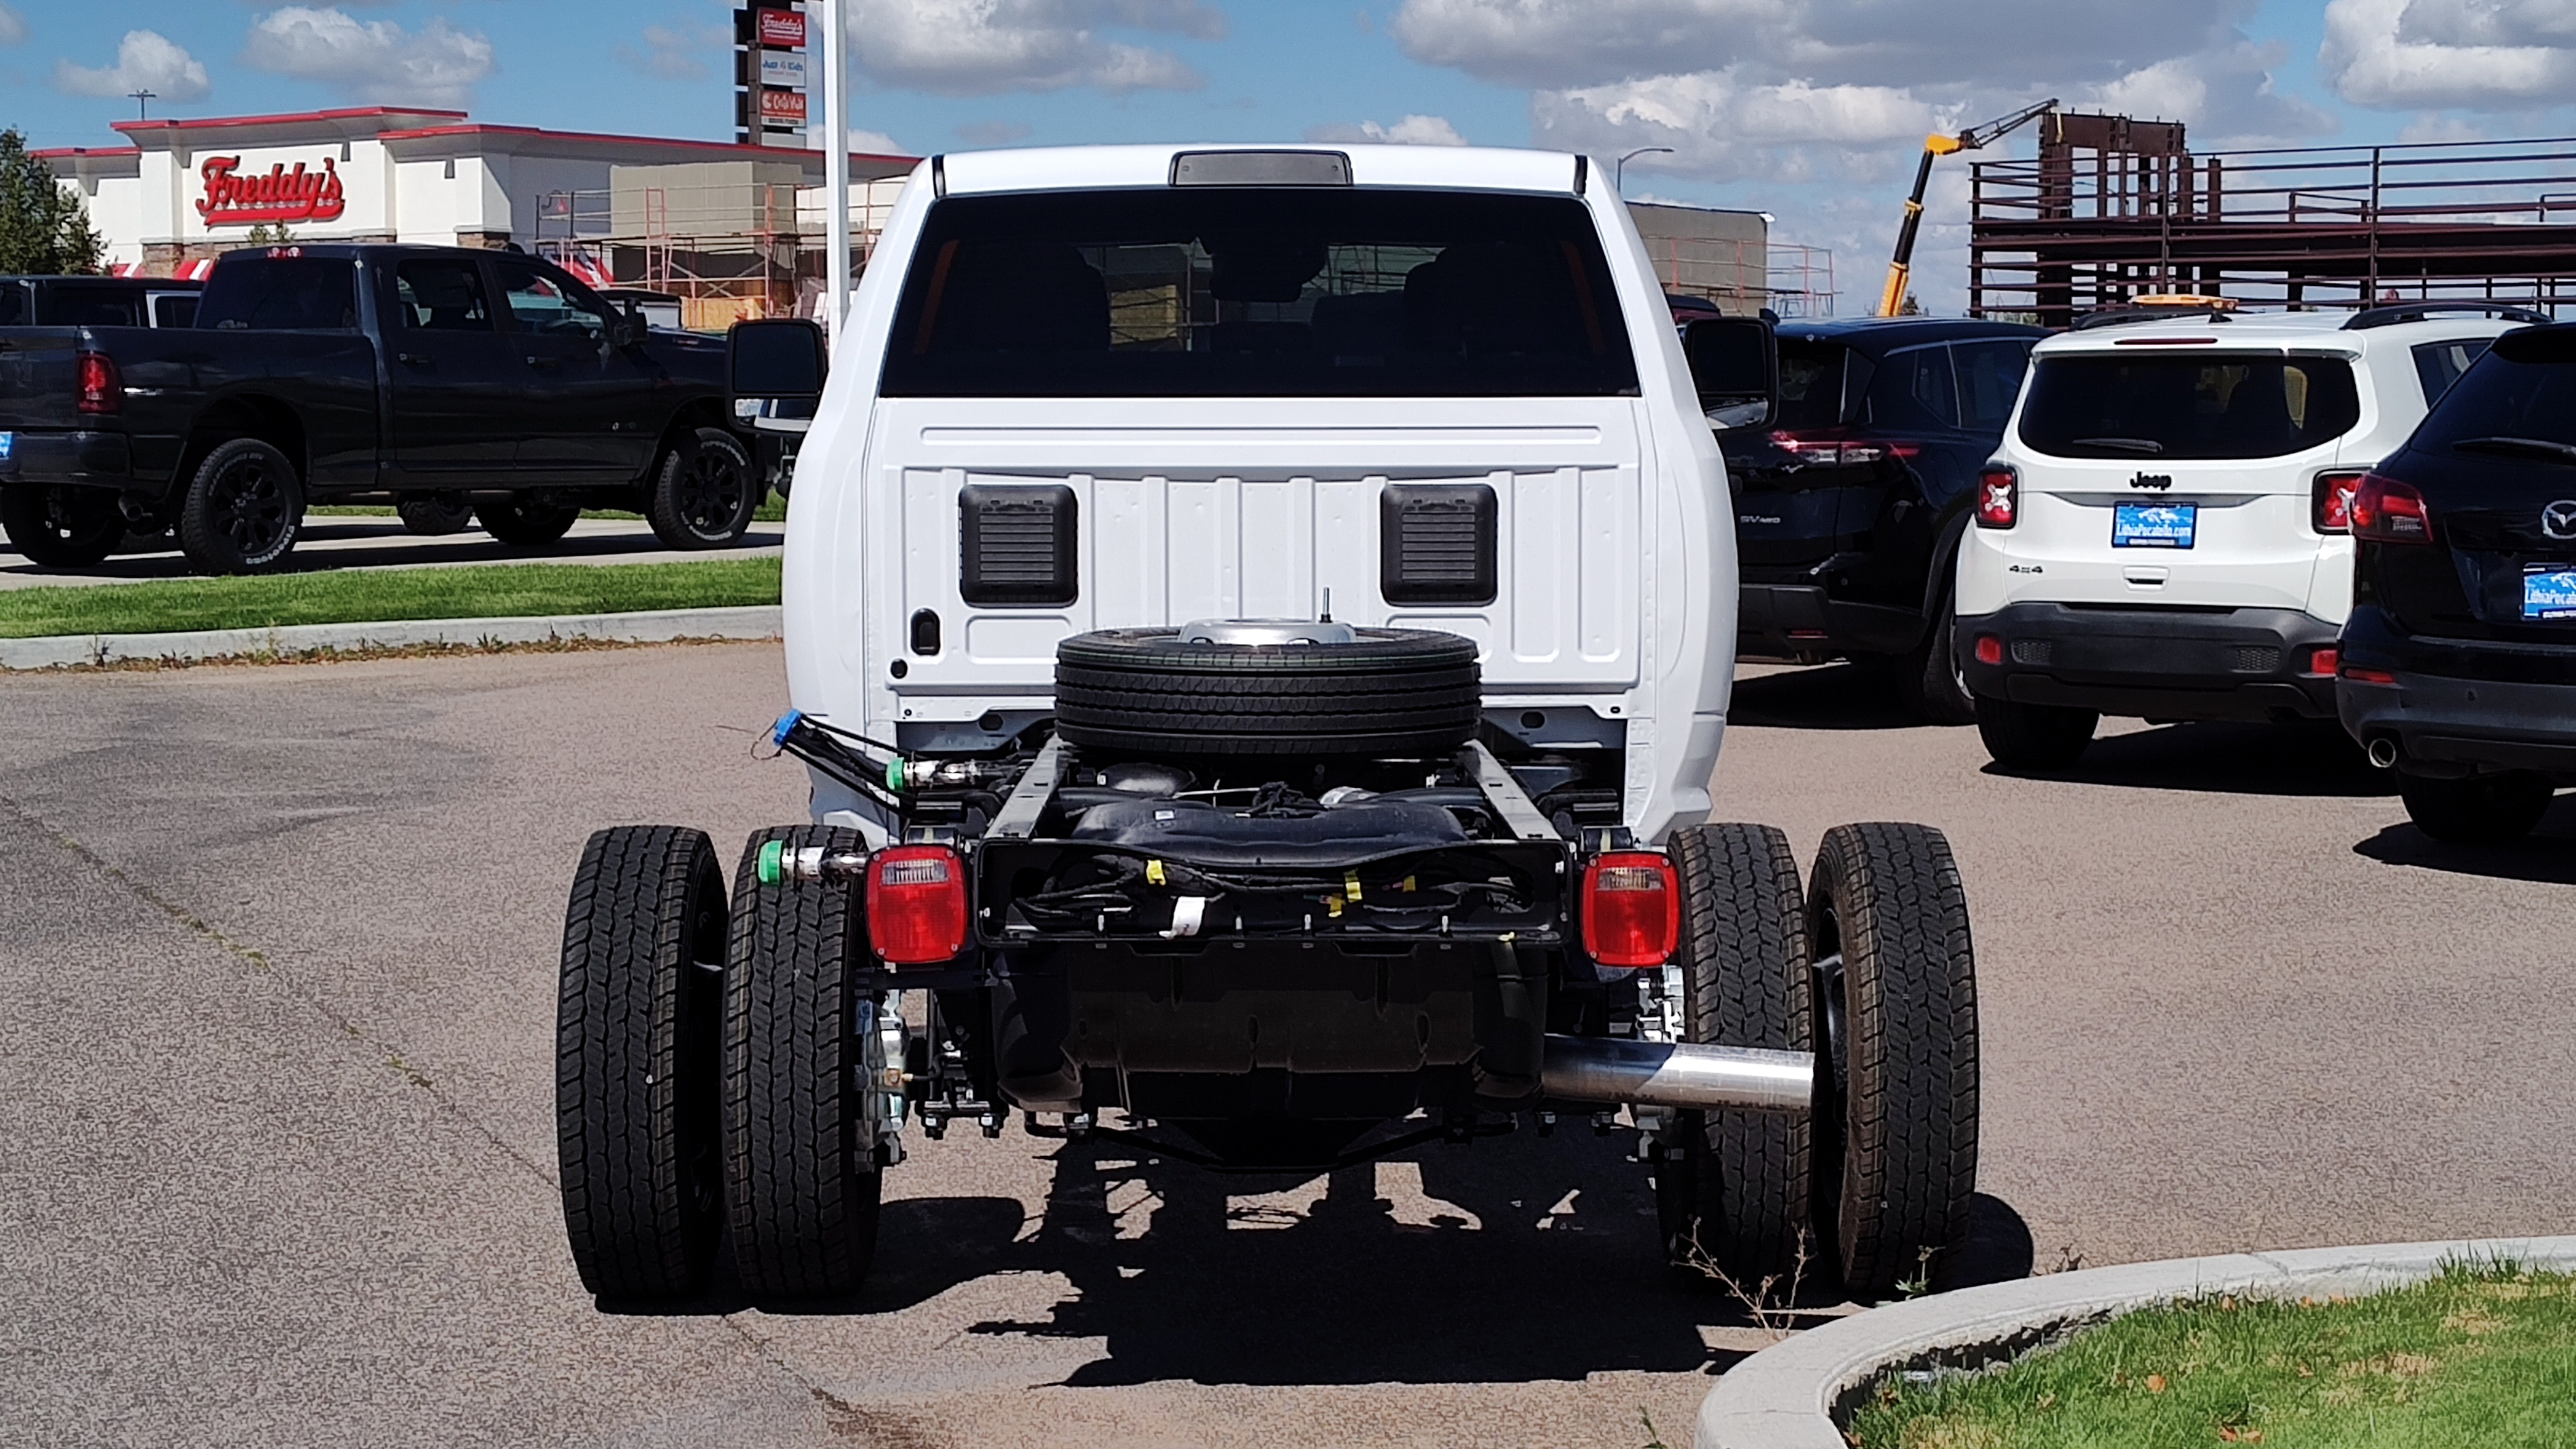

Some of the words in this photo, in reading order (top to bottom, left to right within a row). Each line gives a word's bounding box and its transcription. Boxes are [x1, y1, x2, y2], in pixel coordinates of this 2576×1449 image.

[761, 14, 803, 35] Freddy's
[196, 155, 346, 230] Freddy's
[2130, 471, 2172, 491] Jeep
